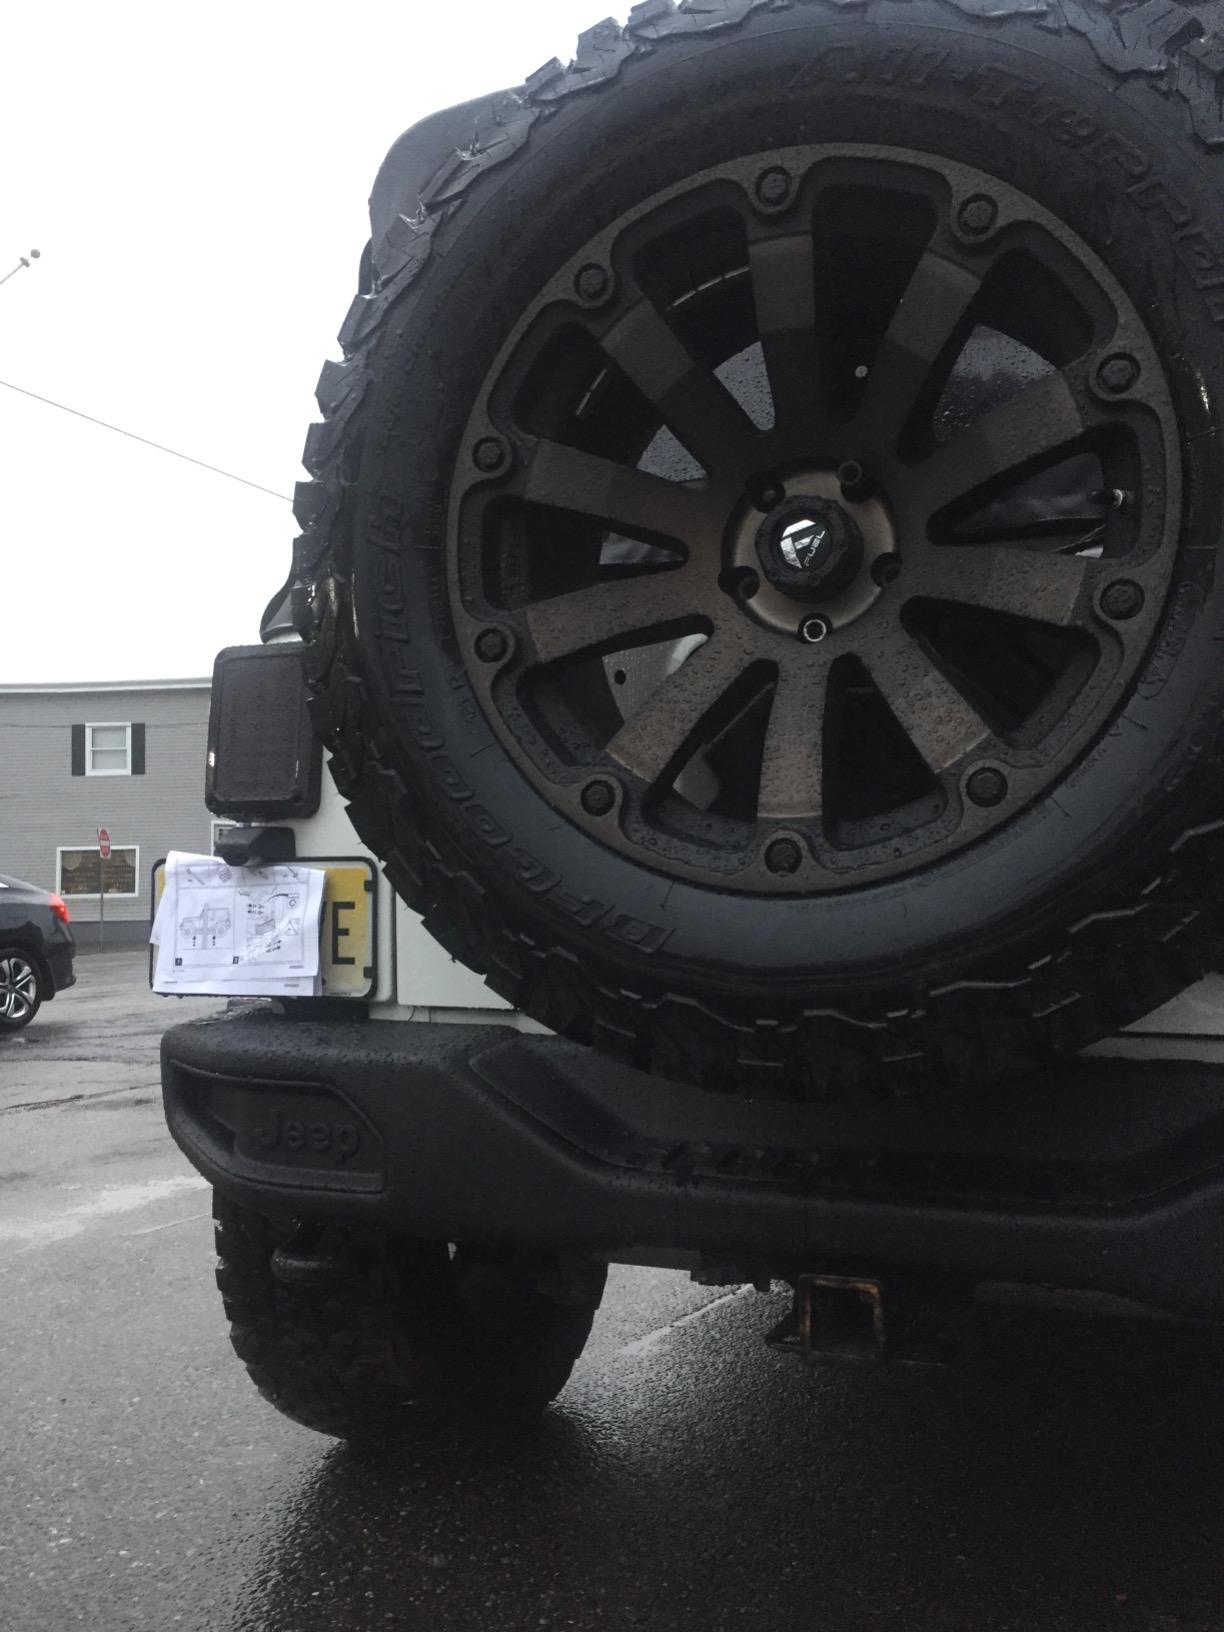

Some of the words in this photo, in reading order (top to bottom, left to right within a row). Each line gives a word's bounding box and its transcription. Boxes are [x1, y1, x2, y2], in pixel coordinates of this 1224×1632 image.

[803, 529, 826, 567] FUEL
[367, 494, 676, 957] BFGoodrich
[332, 901, 356, 965] E
[248, 1105, 361, 1166] Jeep
